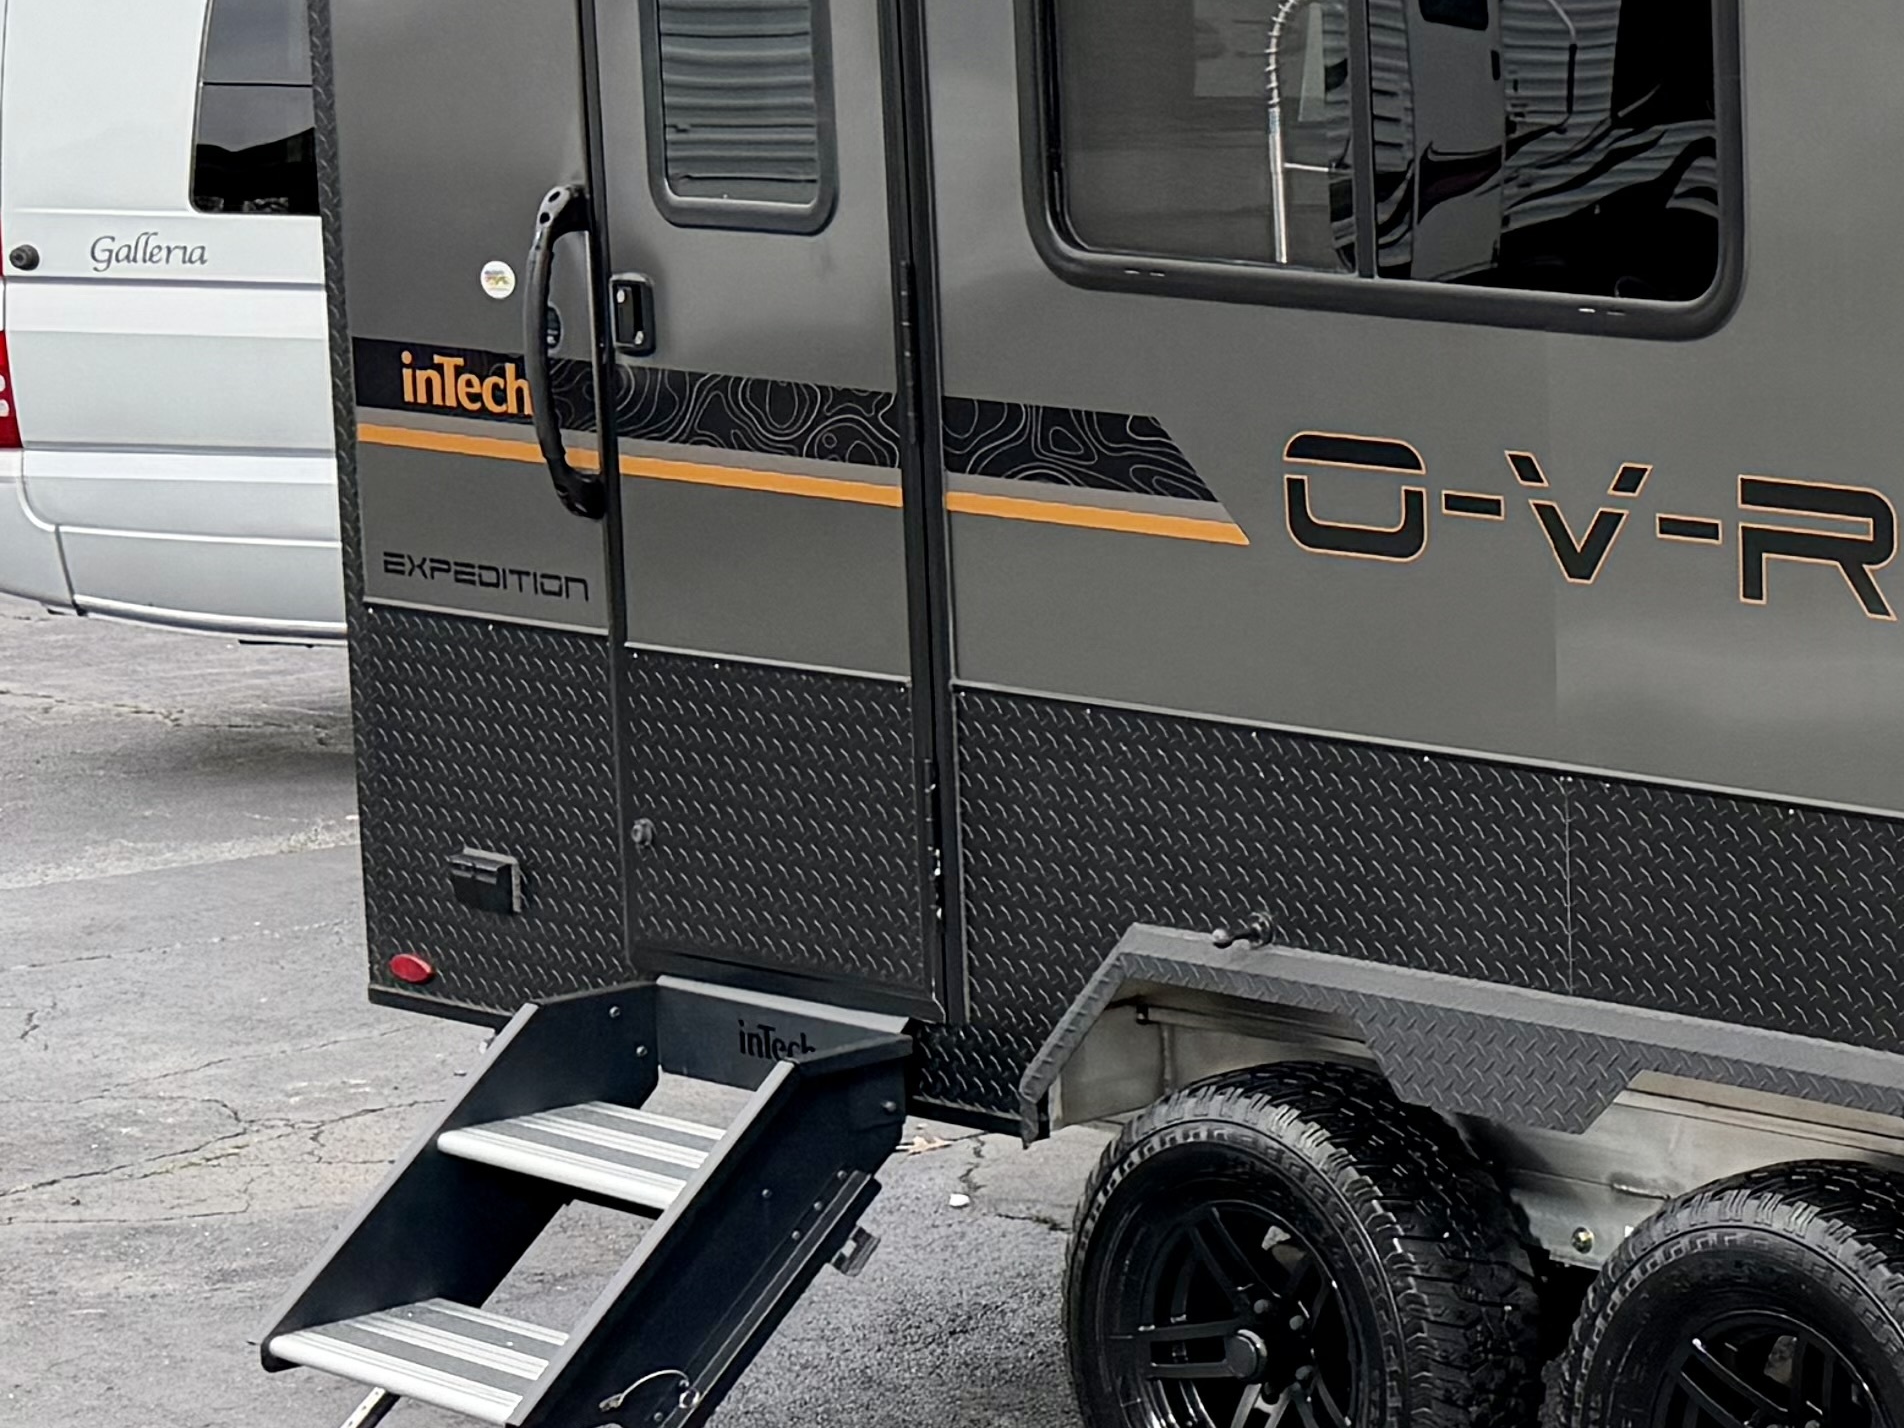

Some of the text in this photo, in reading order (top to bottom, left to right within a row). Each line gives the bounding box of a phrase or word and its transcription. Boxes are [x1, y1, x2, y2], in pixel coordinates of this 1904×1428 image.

[90, 231, 208, 273] Galleria
[401, 350, 534, 416] inTech
[1283, 430, 1899, 622] O-V-R
[383, 551, 590, 603] EXPEDITION
